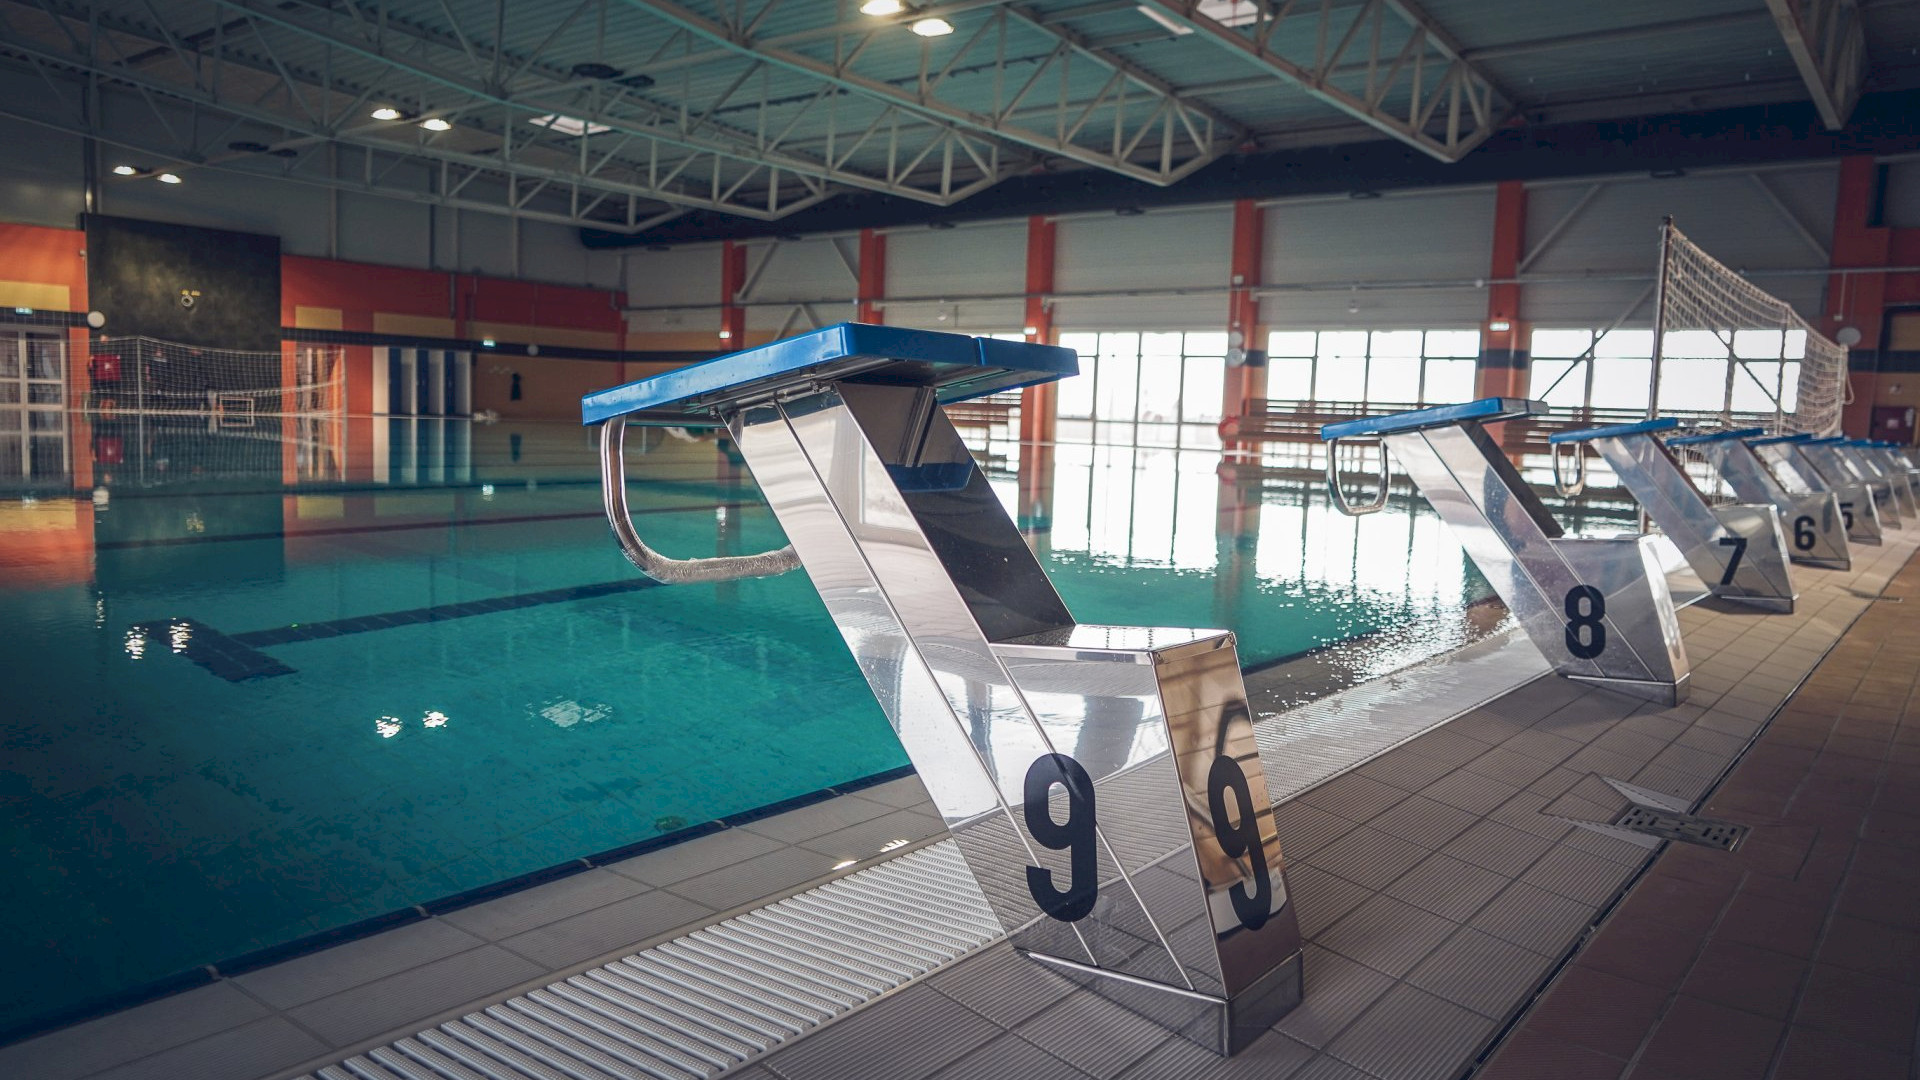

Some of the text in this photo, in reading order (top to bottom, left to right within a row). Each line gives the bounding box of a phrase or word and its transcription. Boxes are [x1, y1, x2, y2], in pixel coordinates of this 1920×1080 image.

[1720, 538, 1747, 585] 7
[1794, 516, 1816, 551] 6
[1565, 585, 1606, 660] 8
[1024, 753, 1098, 922] 9
[1208, 755, 1271, 931] 9
